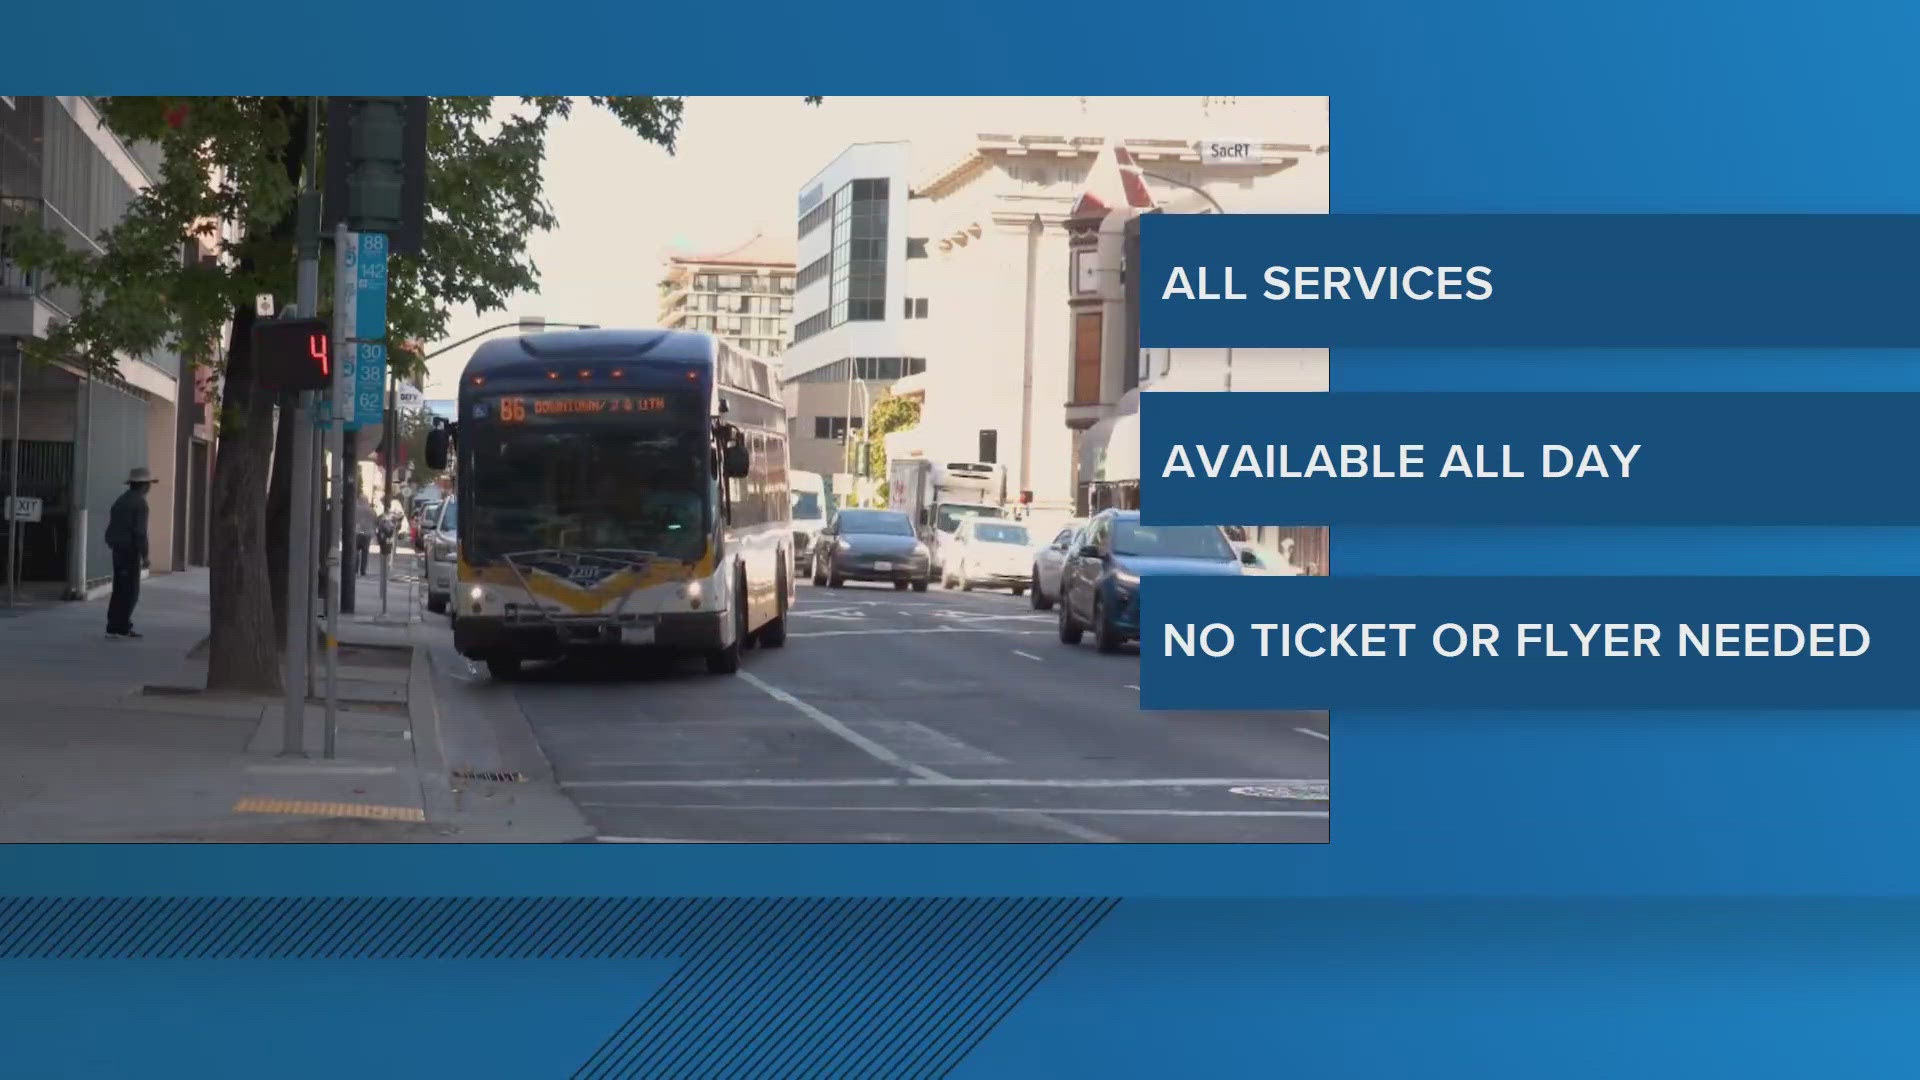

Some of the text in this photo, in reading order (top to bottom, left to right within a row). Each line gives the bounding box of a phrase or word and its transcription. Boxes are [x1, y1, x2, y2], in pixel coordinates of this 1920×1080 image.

[364, 234, 383, 250] 88
[361, 263, 385, 279] 142
[310, 335, 328, 375] 4
[361, 344, 381, 360] 30
[360, 366, 380, 381] 38
[359, 392, 379, 408] 62
